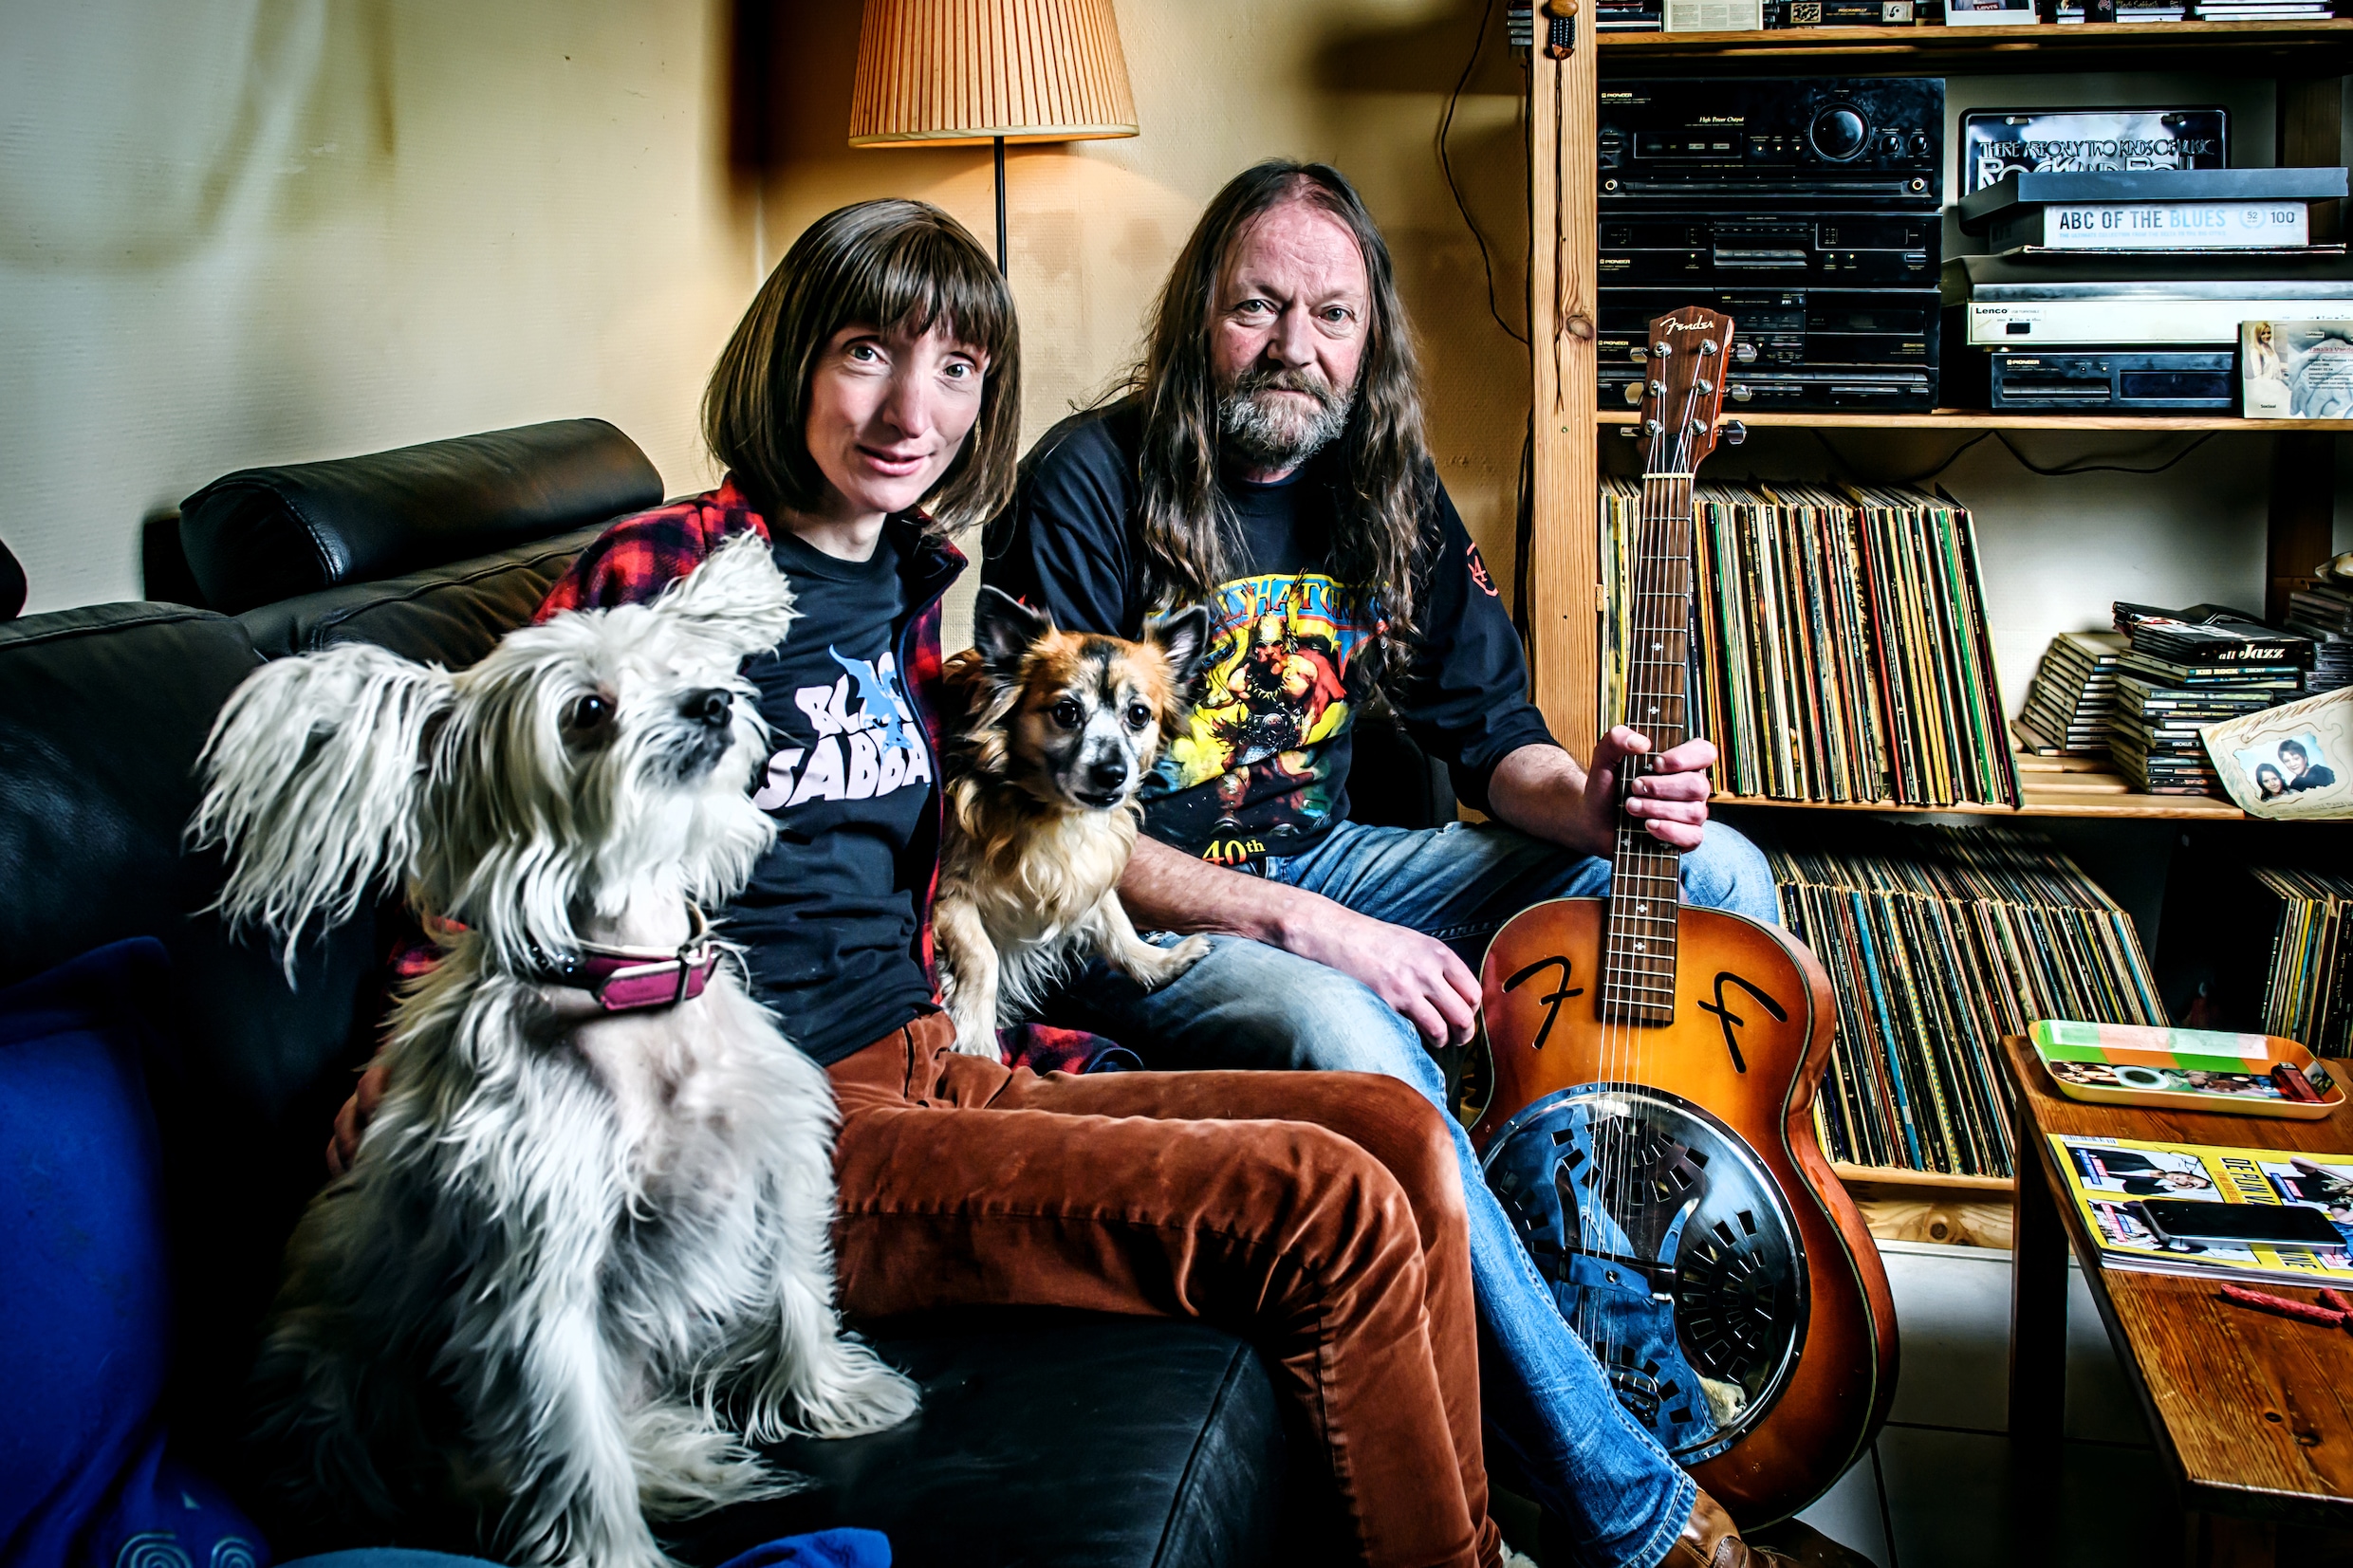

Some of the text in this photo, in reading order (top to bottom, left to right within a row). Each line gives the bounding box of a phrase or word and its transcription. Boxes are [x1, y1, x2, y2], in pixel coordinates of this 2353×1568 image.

[1980, 140, 2020, 158] THERE
[2059, 209, 2226, 230] ABC OF THE BLUES
[2247, 212, 2258, 220] 52
[2270, 211, 2295, 224] 100
[1659, 315, 1714, 336] Fender
[2218, 644, 2286, 660] all Jazz
[751, 721, 933, 811] SABBA
[1200, 839, 1267, 866] 40th
[2220, 1157, 2256, 1172] DE
[2244, 1195, 2276, 1205] VA
